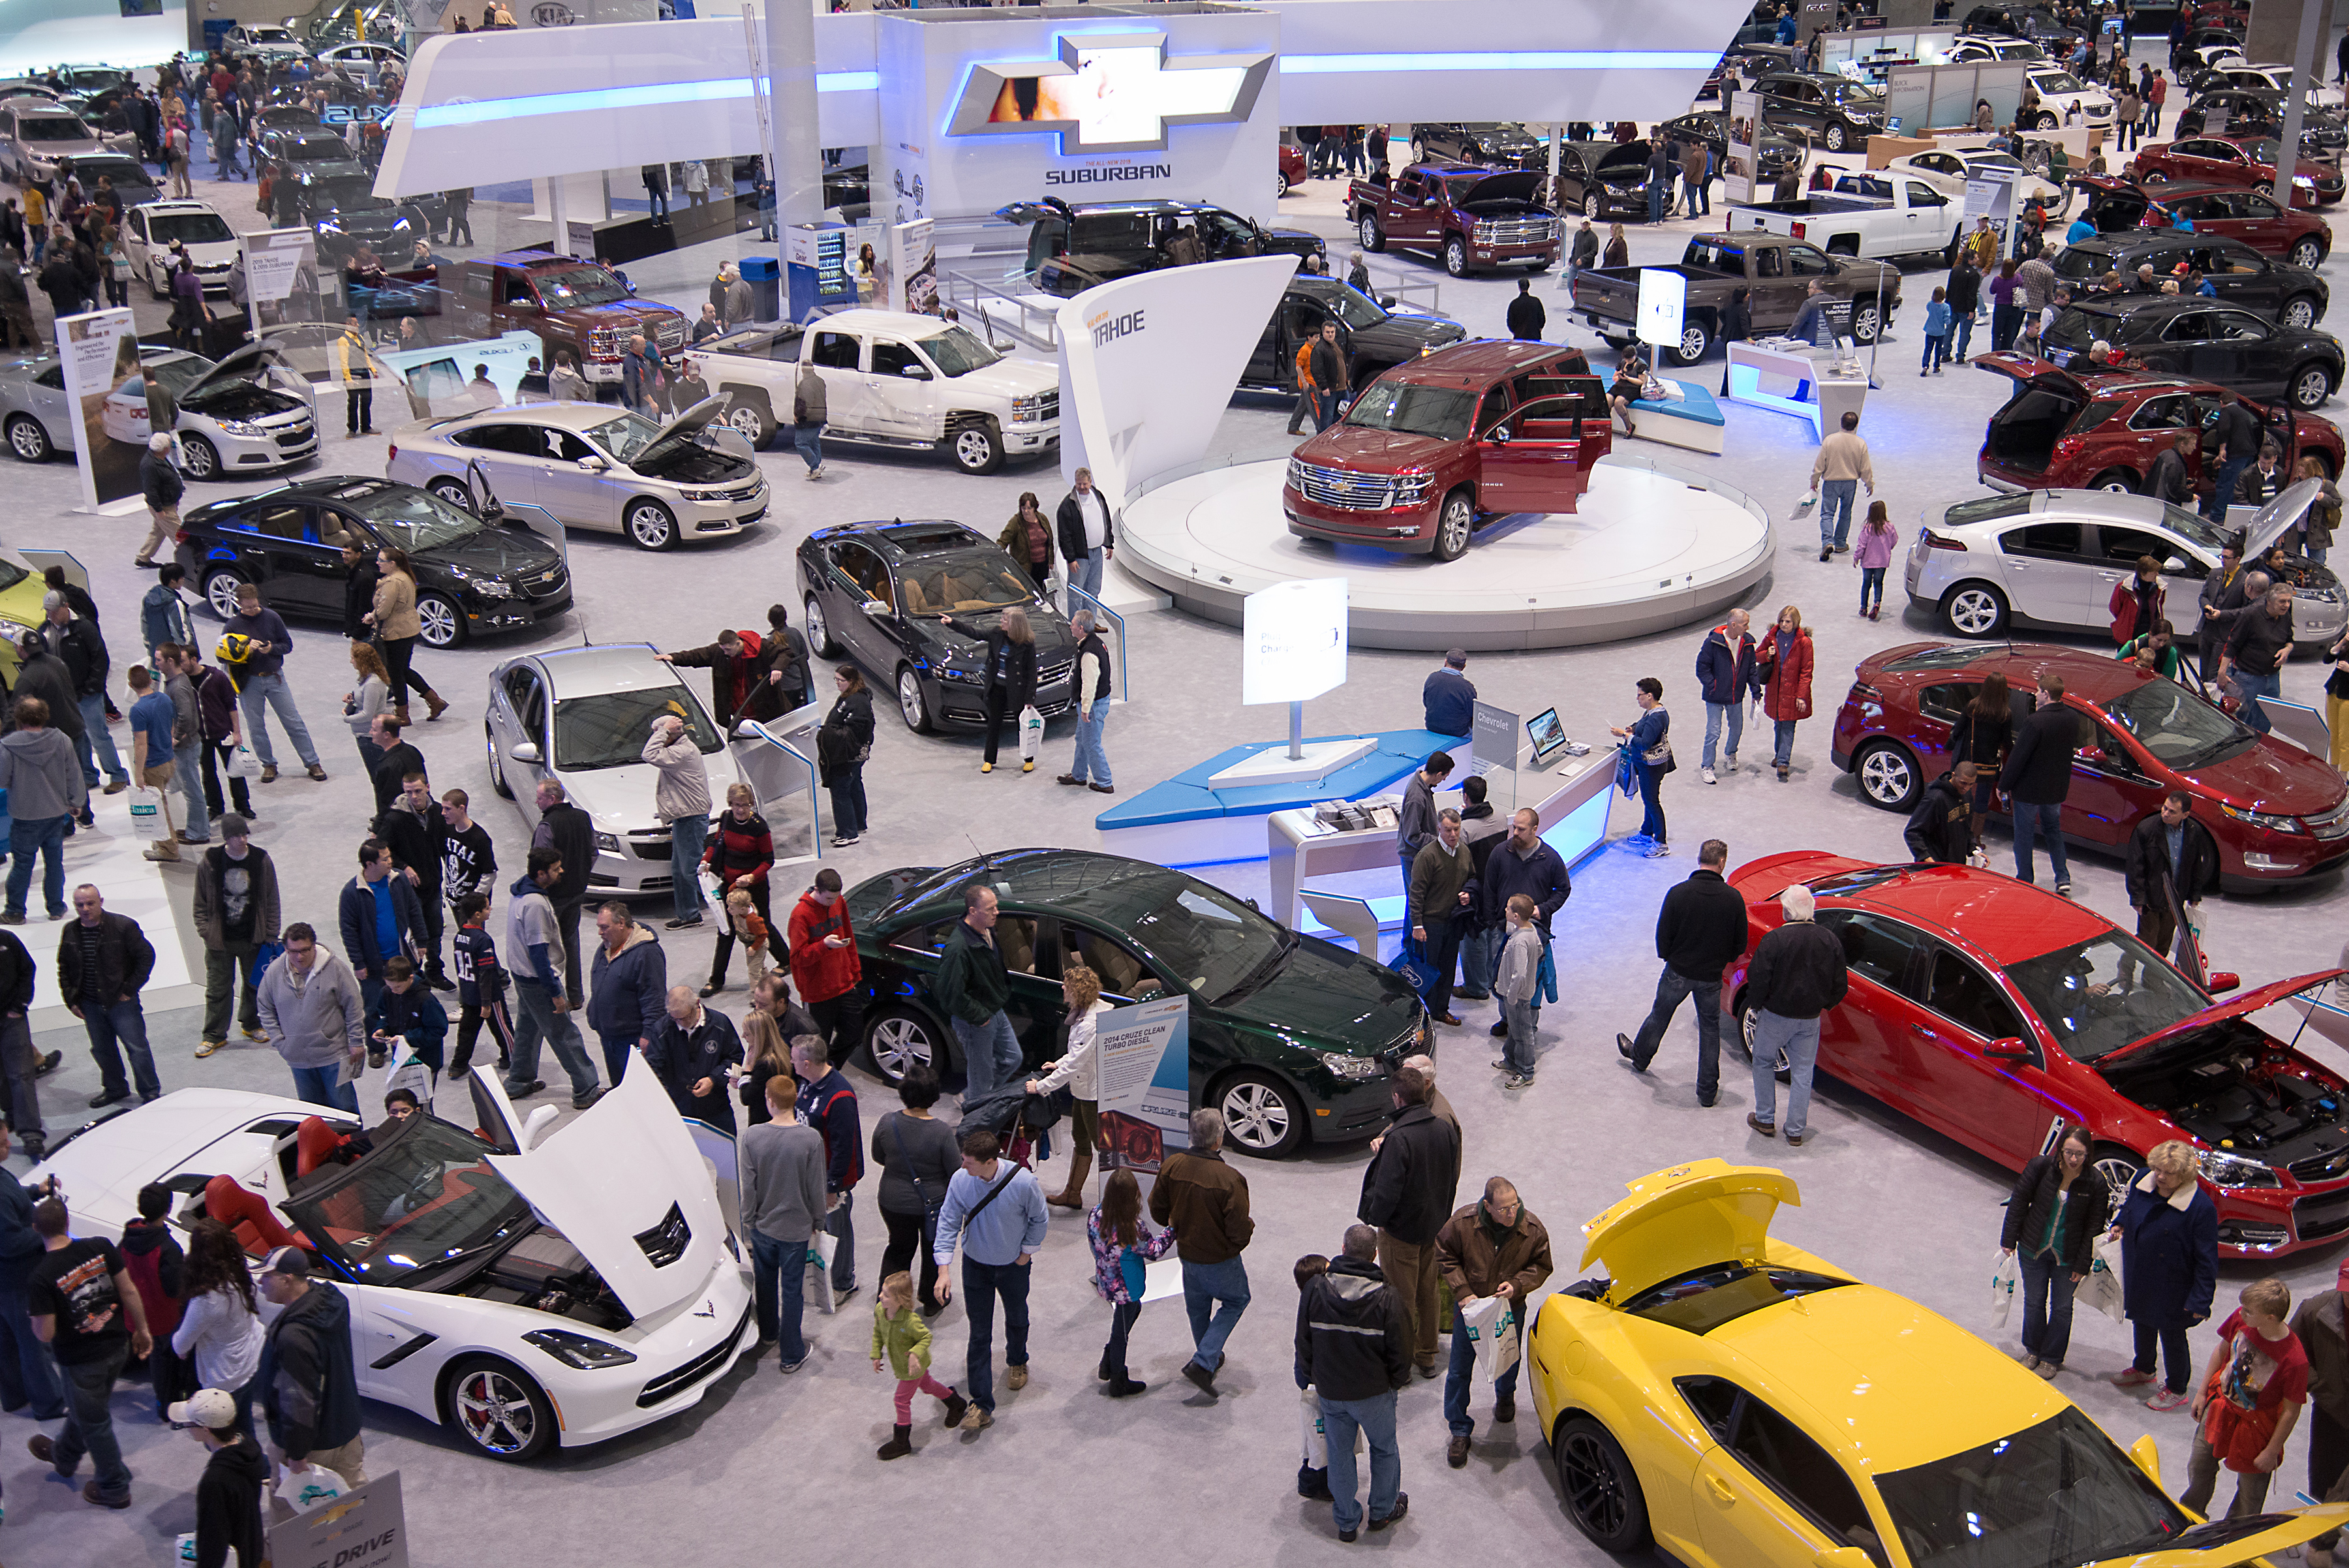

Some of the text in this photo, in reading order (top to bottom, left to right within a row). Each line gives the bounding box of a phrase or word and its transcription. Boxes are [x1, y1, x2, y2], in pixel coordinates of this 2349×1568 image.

[1806, 3, 1832, 12] GMC
[538, 8, 568, 23] KIA
[1045, 164, 1171, 185] SUBURBAN
[795, 253, 807, 262] Gear
[1093, 309, 1145, 349] TAHOE
[75, 342, 98, 352] Engineered
[84, 346, 111, 355] Performance
[1478, 712, 1509, 731] Chevrolet
[130, 805, 155, 814] Amica
[454, 950, 475, 981] 12
[1103, 1025, 1166, 1045] 2014 CRUZE CLEAN
[1104, 1036, 1150, 1052] TURBO DIESEL
[1141, 1104, 1178, 1116] CRUZE
[334, 1528, 395, 1567] DRIVE
[372, 1552, 392, 1566] now!
